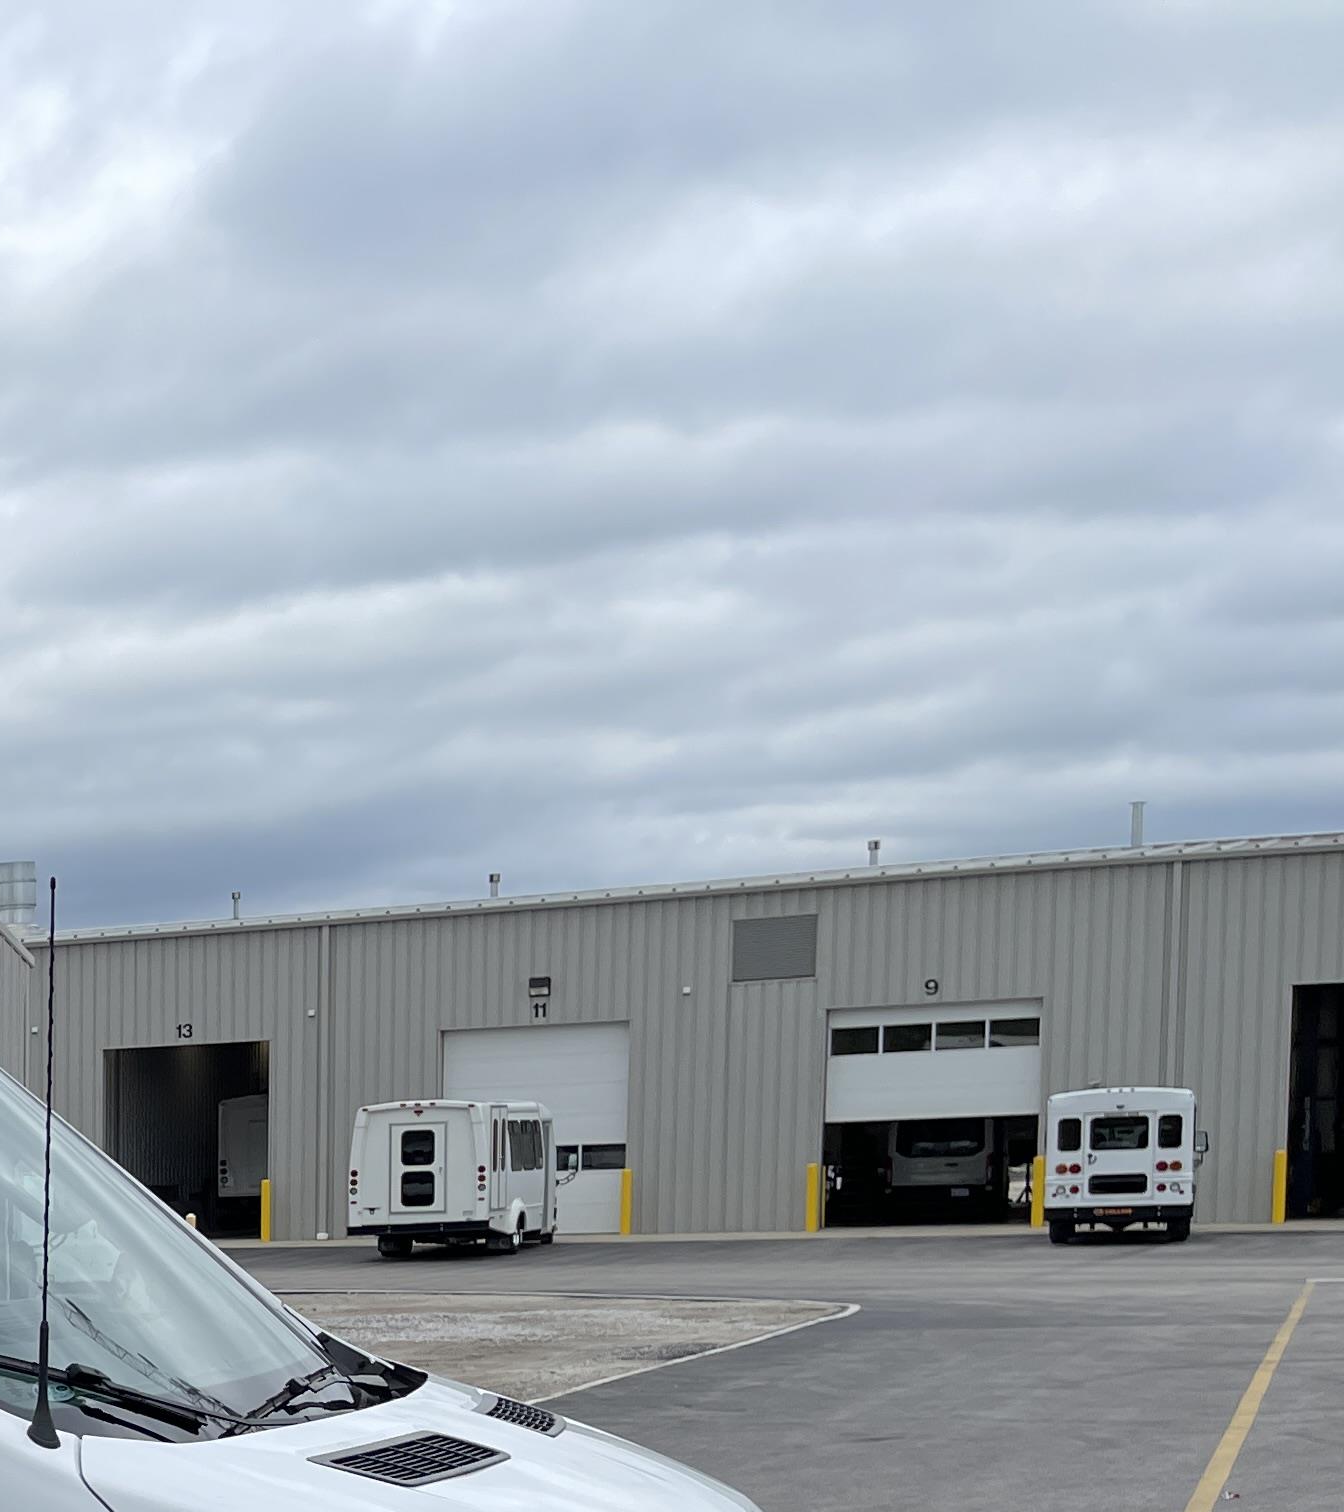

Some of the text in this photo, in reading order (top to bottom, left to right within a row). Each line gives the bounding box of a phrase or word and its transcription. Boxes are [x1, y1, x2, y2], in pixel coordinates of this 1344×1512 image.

[925, 979, 939, 996] 9
[533, 1002, 547, 1018] 11
[176, 1023, 193, 1039] 13
